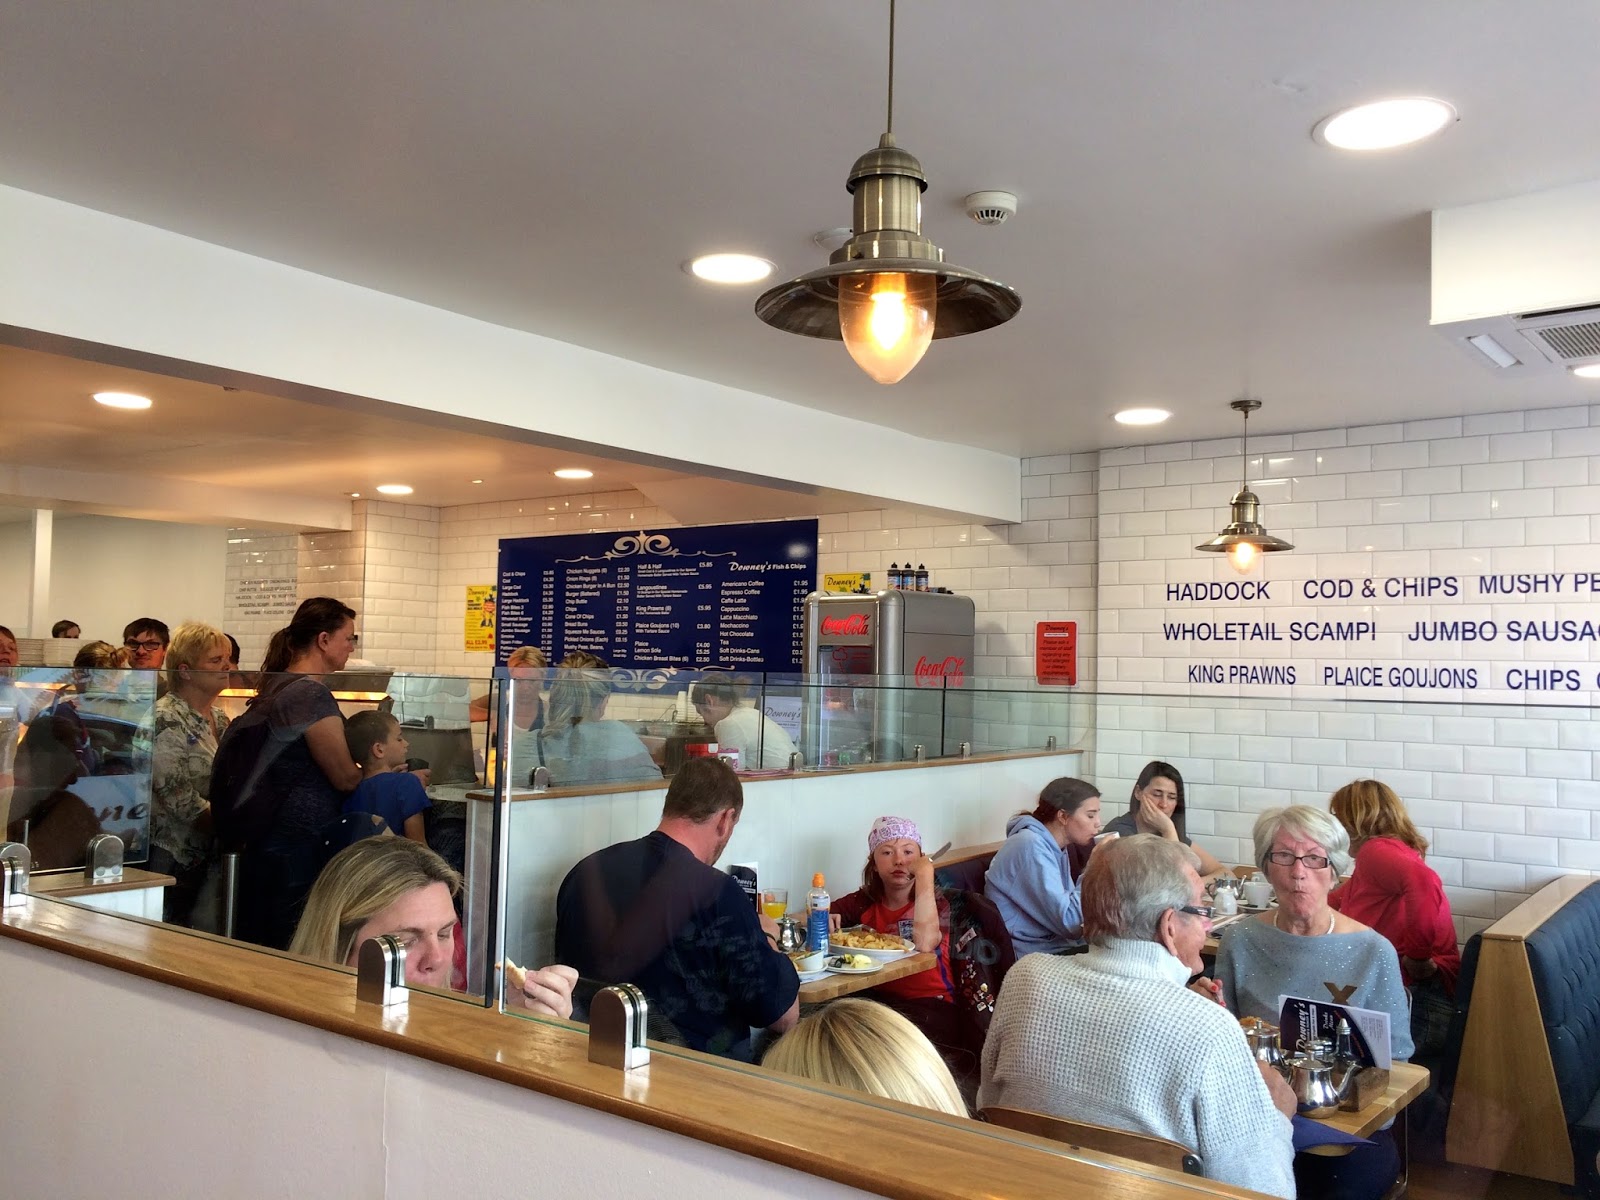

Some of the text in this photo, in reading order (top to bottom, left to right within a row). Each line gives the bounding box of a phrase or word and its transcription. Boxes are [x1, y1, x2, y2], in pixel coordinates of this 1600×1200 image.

[728, 561, 771, 573] Downey's
[827, 575, 857, 589] Downey's
[1166, 581, 1271, 601] HADDOCK
[1303, 579, 1354, 599] COD
[1361, 578, 1377, 598] &
[1384, 576, 1459, 598] CHIPS
[1479, 574, 1566, 594] MUSHY
[820, 613, 870, 636] Coca-Cola
[1163, 620, 1600, 642] WHOLETAIL SCAMPI JUMBO SAUSA
[1188, 664, 1224, 684] KING
[1229, 665, 1297, 685] PRAWNS
[1324, 666, 1383, 687] PLAICE
[1388, 667, 1478, 689] GOUJONS
[1506, 668, 1581, 691] CHIPS
[765, 706, 800, 720] Downey's
[1294, 1002, 1309, 1050] Downey's
